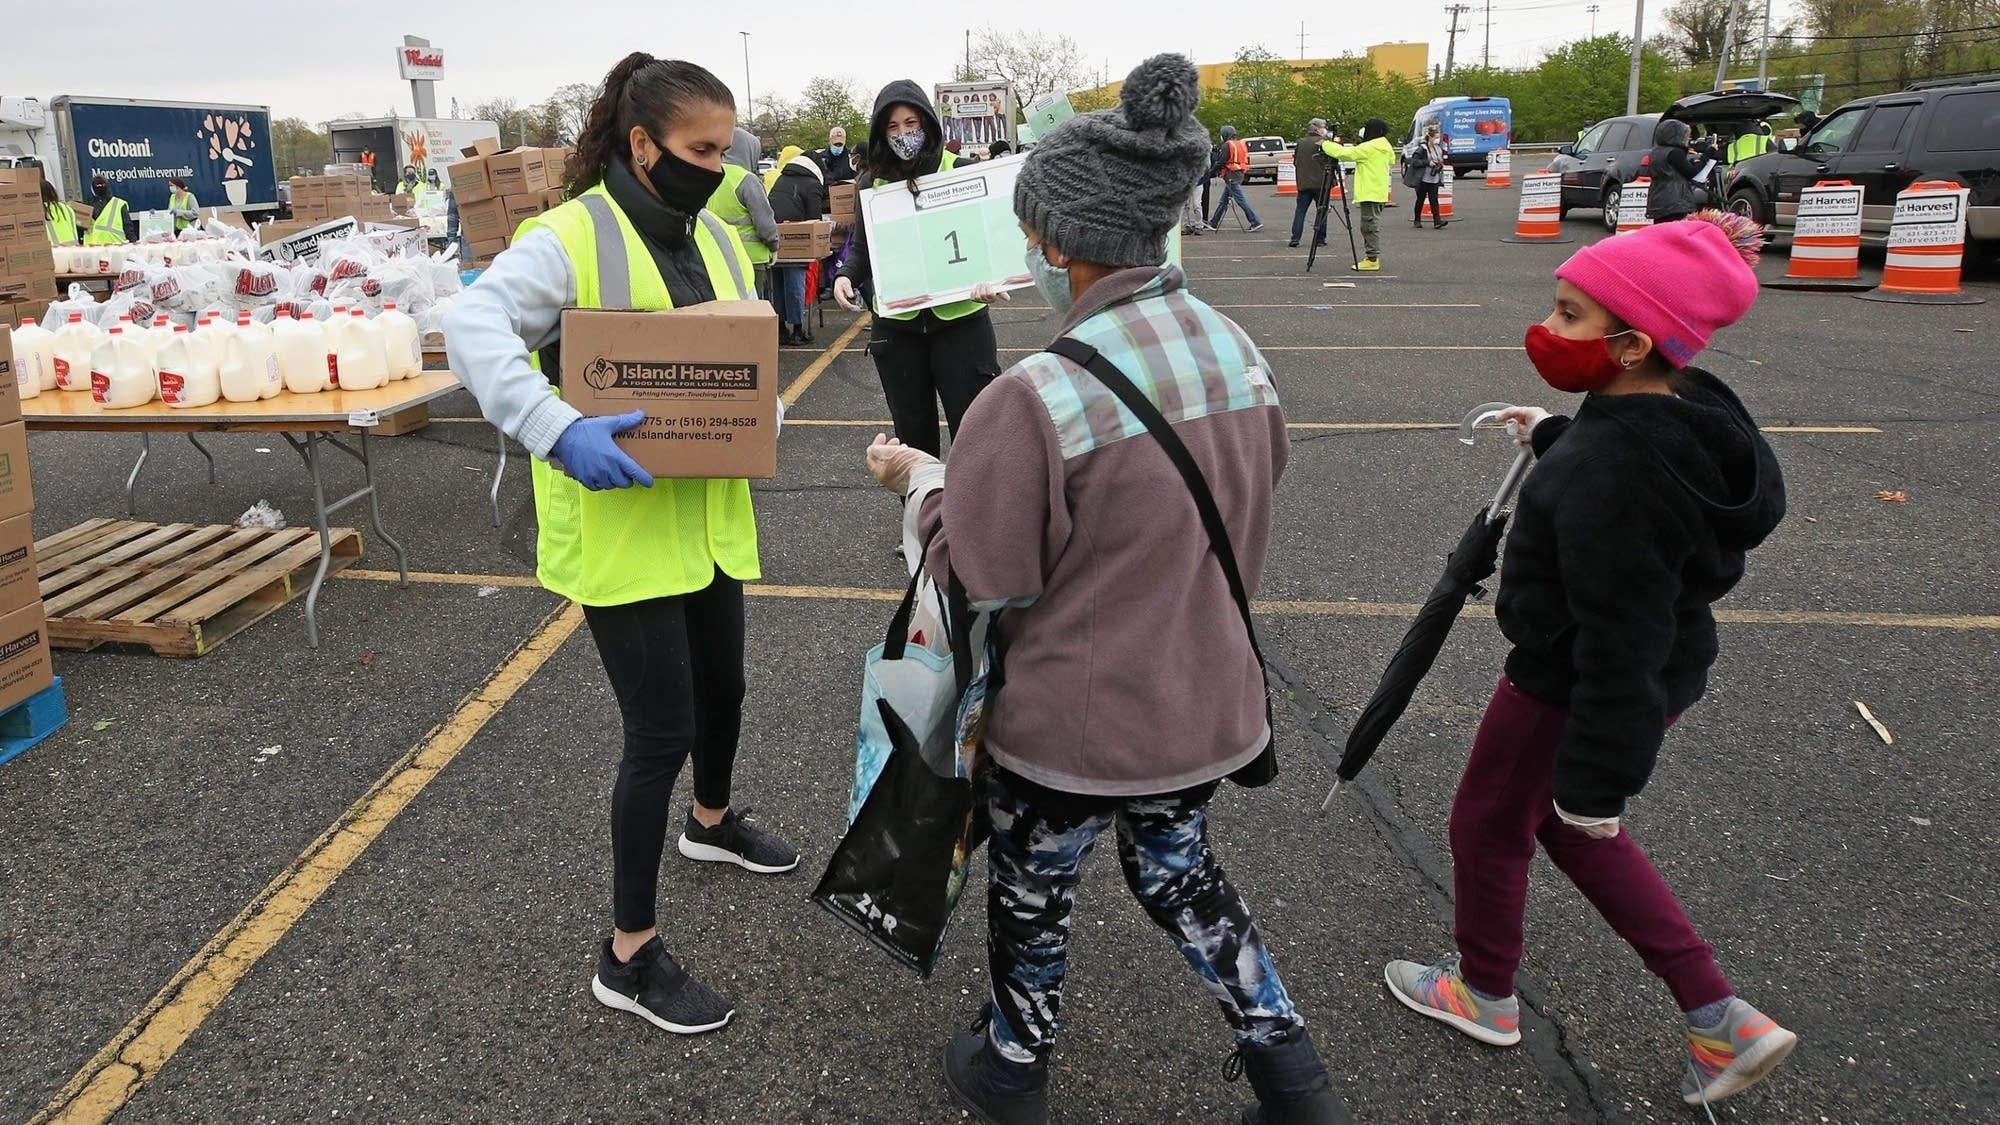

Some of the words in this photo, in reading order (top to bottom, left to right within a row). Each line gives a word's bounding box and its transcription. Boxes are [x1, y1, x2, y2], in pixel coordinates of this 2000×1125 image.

[1046, 113, 1055, 124] 3
[88, 138, 152, 158] Chobani
[92, 168, 116, 180] More
[116, 167, 137, 182] good
[137, 167, 156, 178] with
[156, 169, 177, 178] every
[178, 166, 194, 177] mile
[927, 189, 951, 200] Island
[951, 182, 982, 194] Harvest
[1815, 196, 1856, 205] Harvest
[1907, 202, 1953, 212] Harvest
[293, 235, 317, 253] Island
[944, 230, 968, 264] 1
[622, 364, 677, 380] Island
[680, 365, 750, 381] Harvest
[632, 390, 660, 398] Fighting
[687, 391, 718, 399] Touching
[665, 418, 677, 426] or
[680, 416, 707, 428] (516)
[709, 417, 757, 427] 294-8528
[5, 633, 37, 654] Harvest
